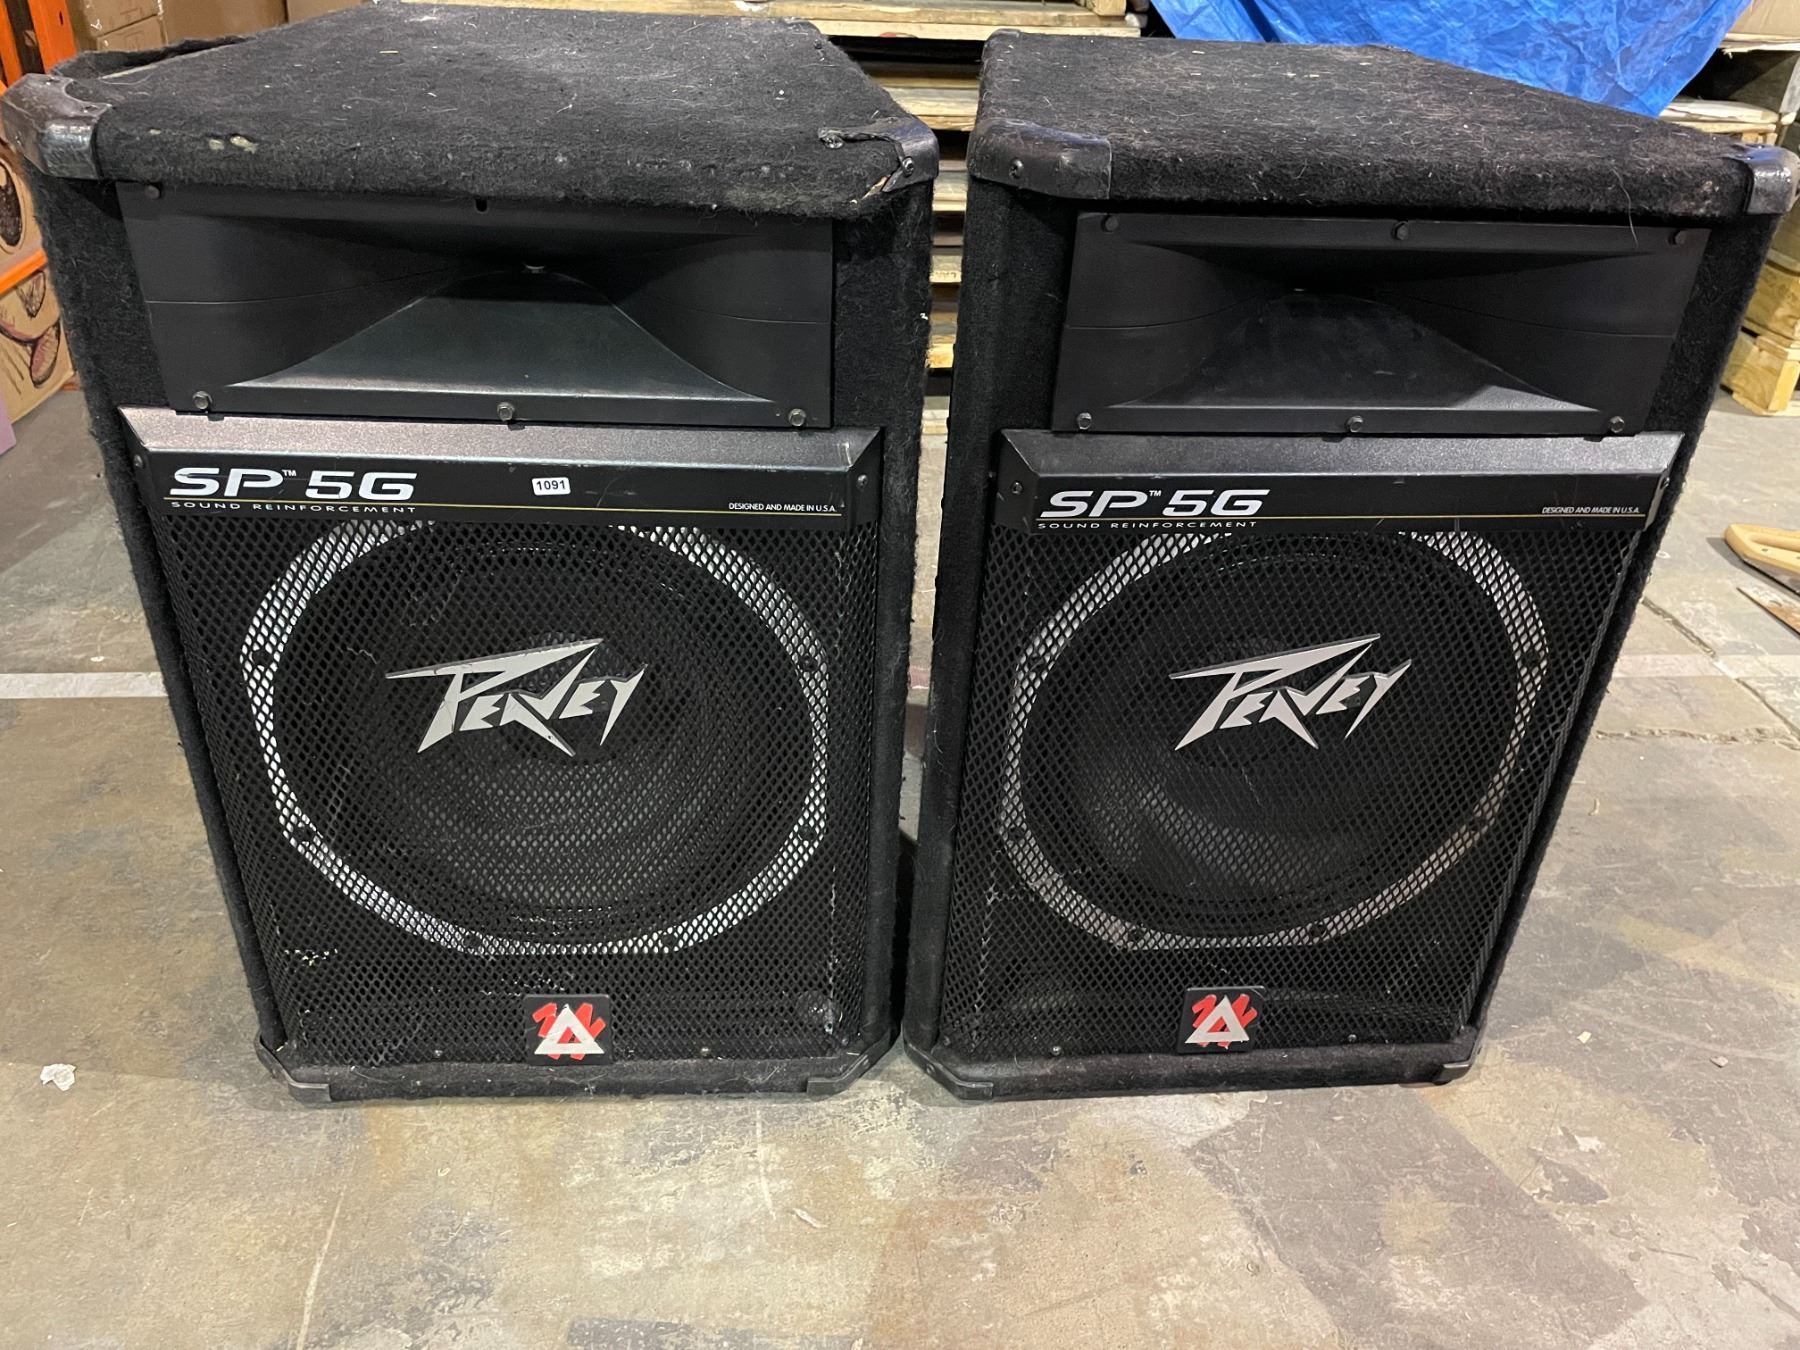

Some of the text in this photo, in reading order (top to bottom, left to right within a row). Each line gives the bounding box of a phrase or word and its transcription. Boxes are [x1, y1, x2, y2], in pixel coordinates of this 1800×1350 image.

[305, 470, 417, 500] 5G
[536, 480, 565, 490] 1091
[171, 502, 416, 513] SOUND REINFORCEMENT
[1162, 489, 1270, 516] 5G
[1542, 506, 1574, 514] DESIGNED
[1110, 521, 1257, 529] REINFORCEMENT
